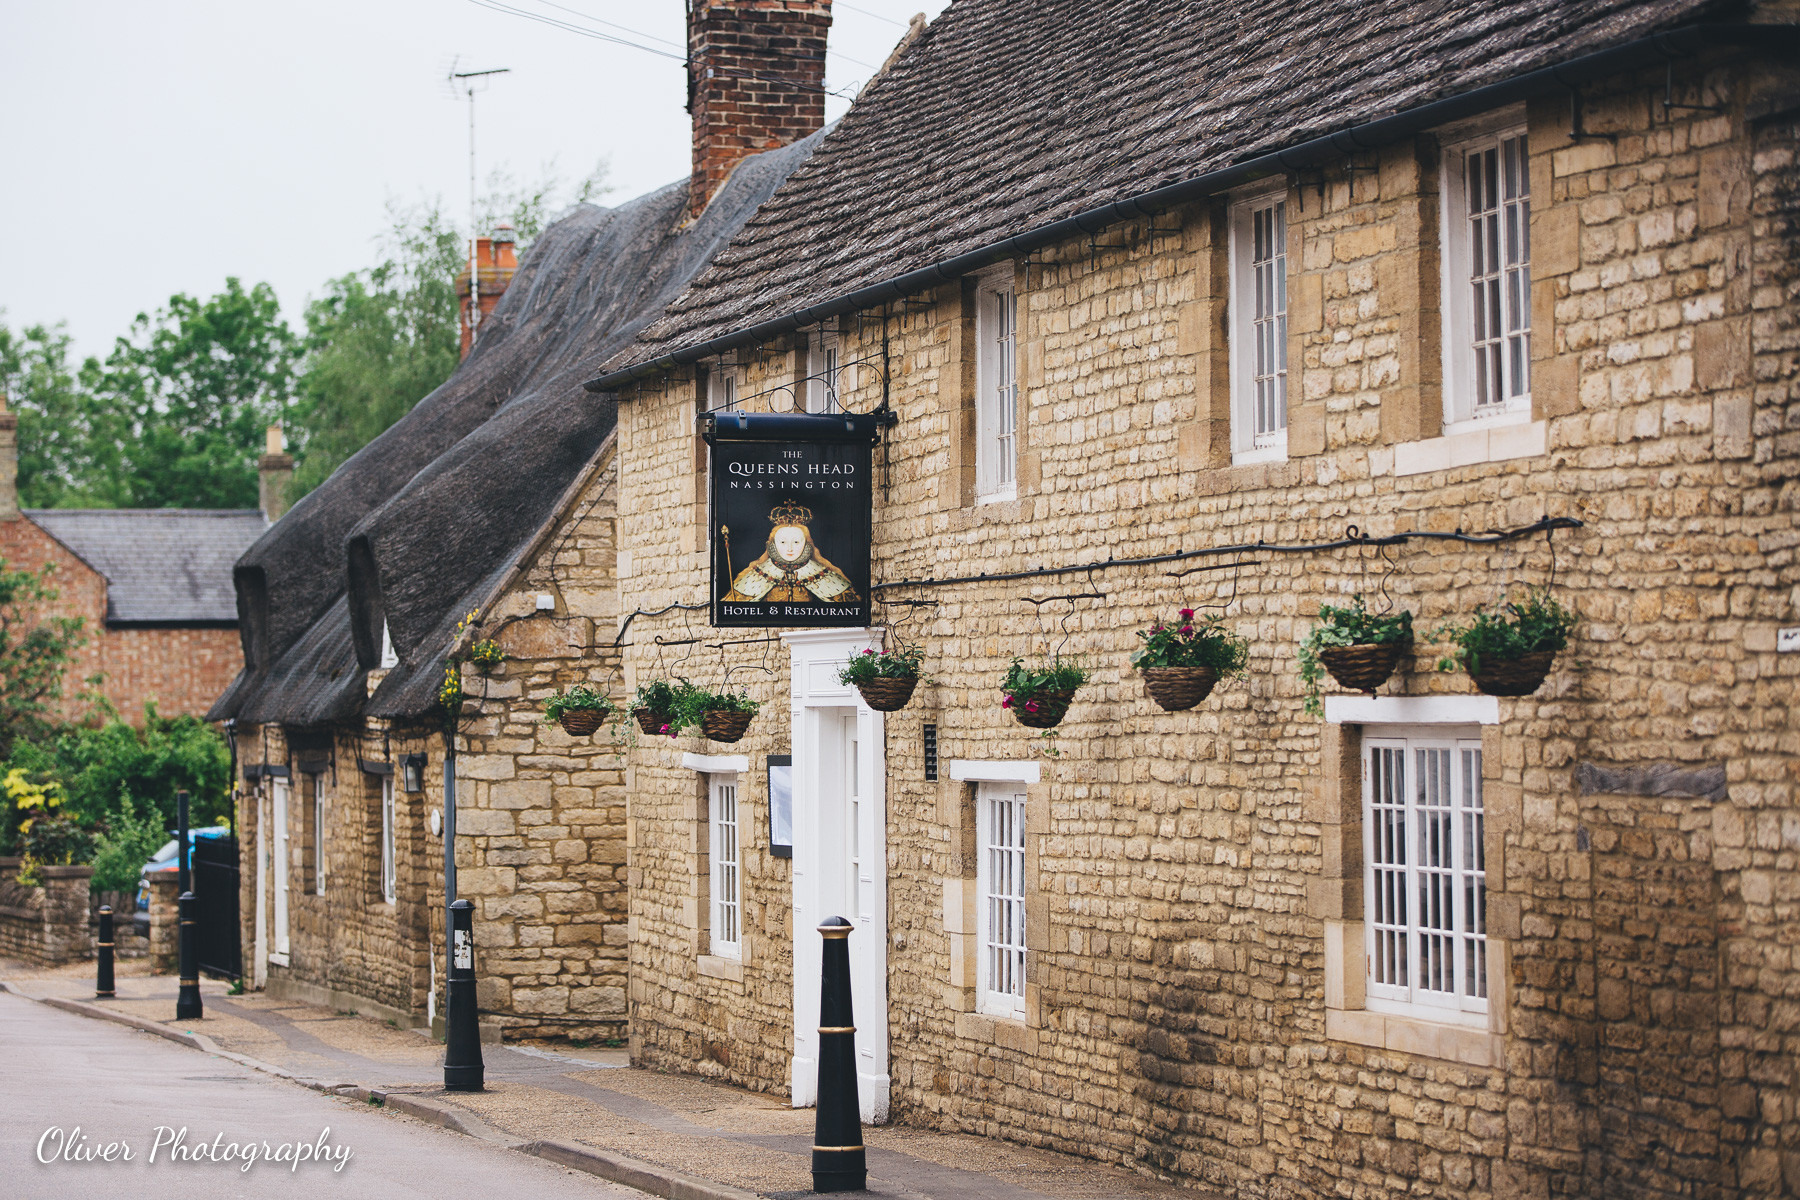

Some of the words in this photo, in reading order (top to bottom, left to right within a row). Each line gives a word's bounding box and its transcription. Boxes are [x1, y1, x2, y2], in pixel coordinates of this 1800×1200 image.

[728, 461, 799, 476] QUEENS
[808, 464, 855, 475] HEAD
[730, 481, 854, 489] NASSINGTON
[723, 606, 763, 616] HOTEL
[769, 606, 779, 616] &
[784, 606, 860, 616] RESTAURANT
